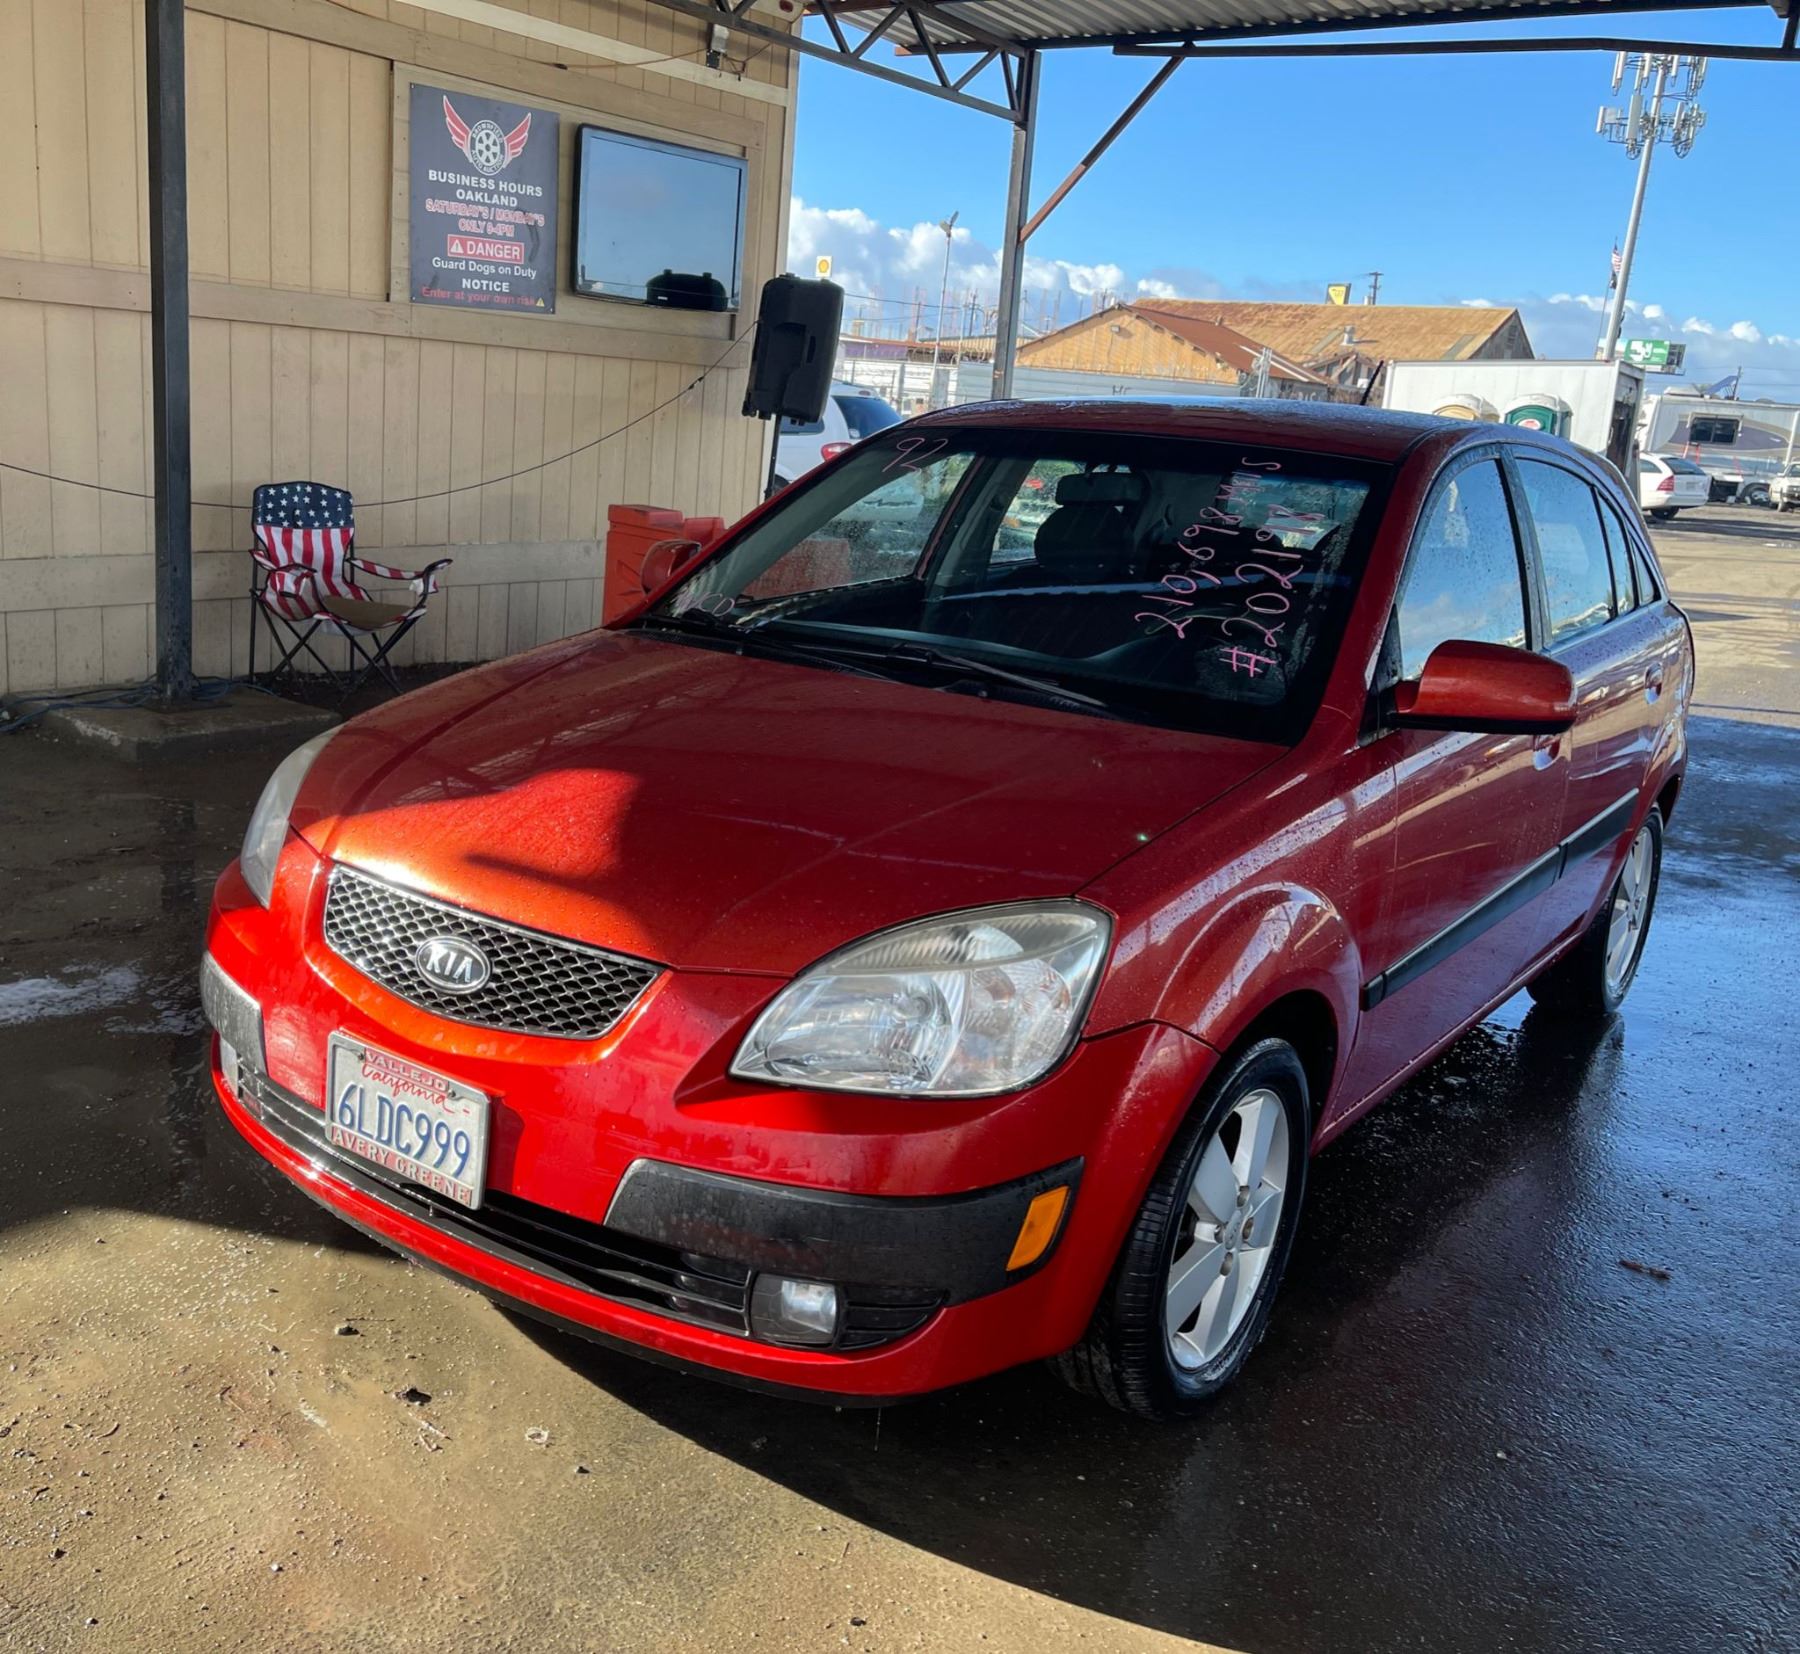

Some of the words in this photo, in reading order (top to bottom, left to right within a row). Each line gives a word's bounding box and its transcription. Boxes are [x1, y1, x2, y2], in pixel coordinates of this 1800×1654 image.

[428, 169, 496, 190] BUSINESS
[498, 181, 543, 197] HOURS
[456, 189, 518, 207] OAKLAND
[458, 218, 486, 233] ONLY
[466, 241, 521, 260] DANGER
[432, 257, 466, 271] Guard
[468, 261, 496, 275] Dogs
[498, 266, 511, 275] on
[514, 266, 537, 280] Duty
[422, 287, 451, 298] Enter
[454, 290, 465, 300] at
[467, 293, 491, 304] your
[495, 294, 513, 304] own
[462, 278, 510, 293] NOTICE
[426, 944, 473, 984] KIA
[365, 1049, 448, 1093] VALLEJO
[338, 1083, 471, 1179] 6LDC999
[333, 1127, 389, 1167] AVERY
[395, 1157, 471, 1204] GREENE
